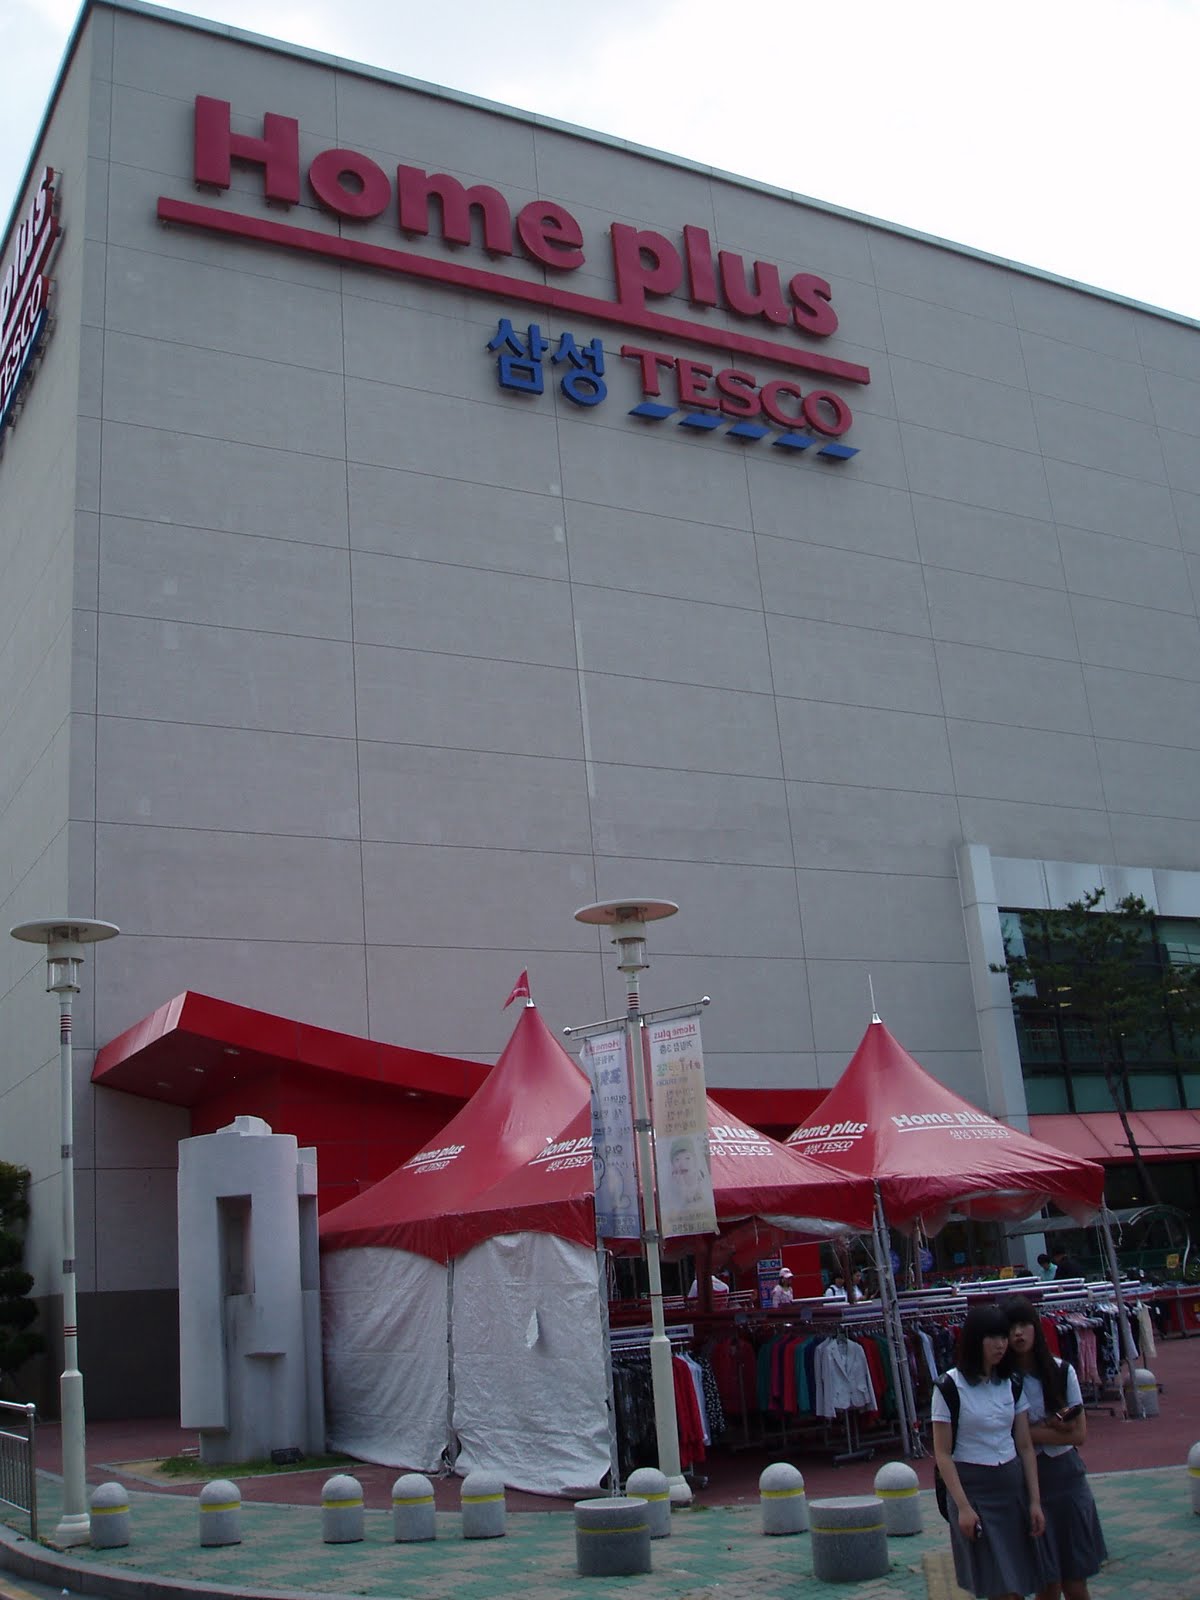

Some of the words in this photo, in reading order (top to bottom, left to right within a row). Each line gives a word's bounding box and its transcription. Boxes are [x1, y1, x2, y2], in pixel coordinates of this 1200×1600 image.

[194, 95, 585, 271] Home
[611, 221, 839, 338] plus
[487, 318, 609, 408] 삼성
[620, 345, 853, 438] TESCO
[891, 1112, 950, 1128] Home
[952, 1112, 1000, 1125] plus
[711, 1125, 760, 1141] plus
[787, 1125, 829, 1142] Home
[829, 1121, 868, 1136] plus
[971, 1129, 1009, 1138] TESCO
[437, 1144, 465, 1160] plus
[727, 1145, 771, 1155] TESCO
[819, 1140, 853, 1151] TESCO
[562, 1155, 593, 1167] TESCO
